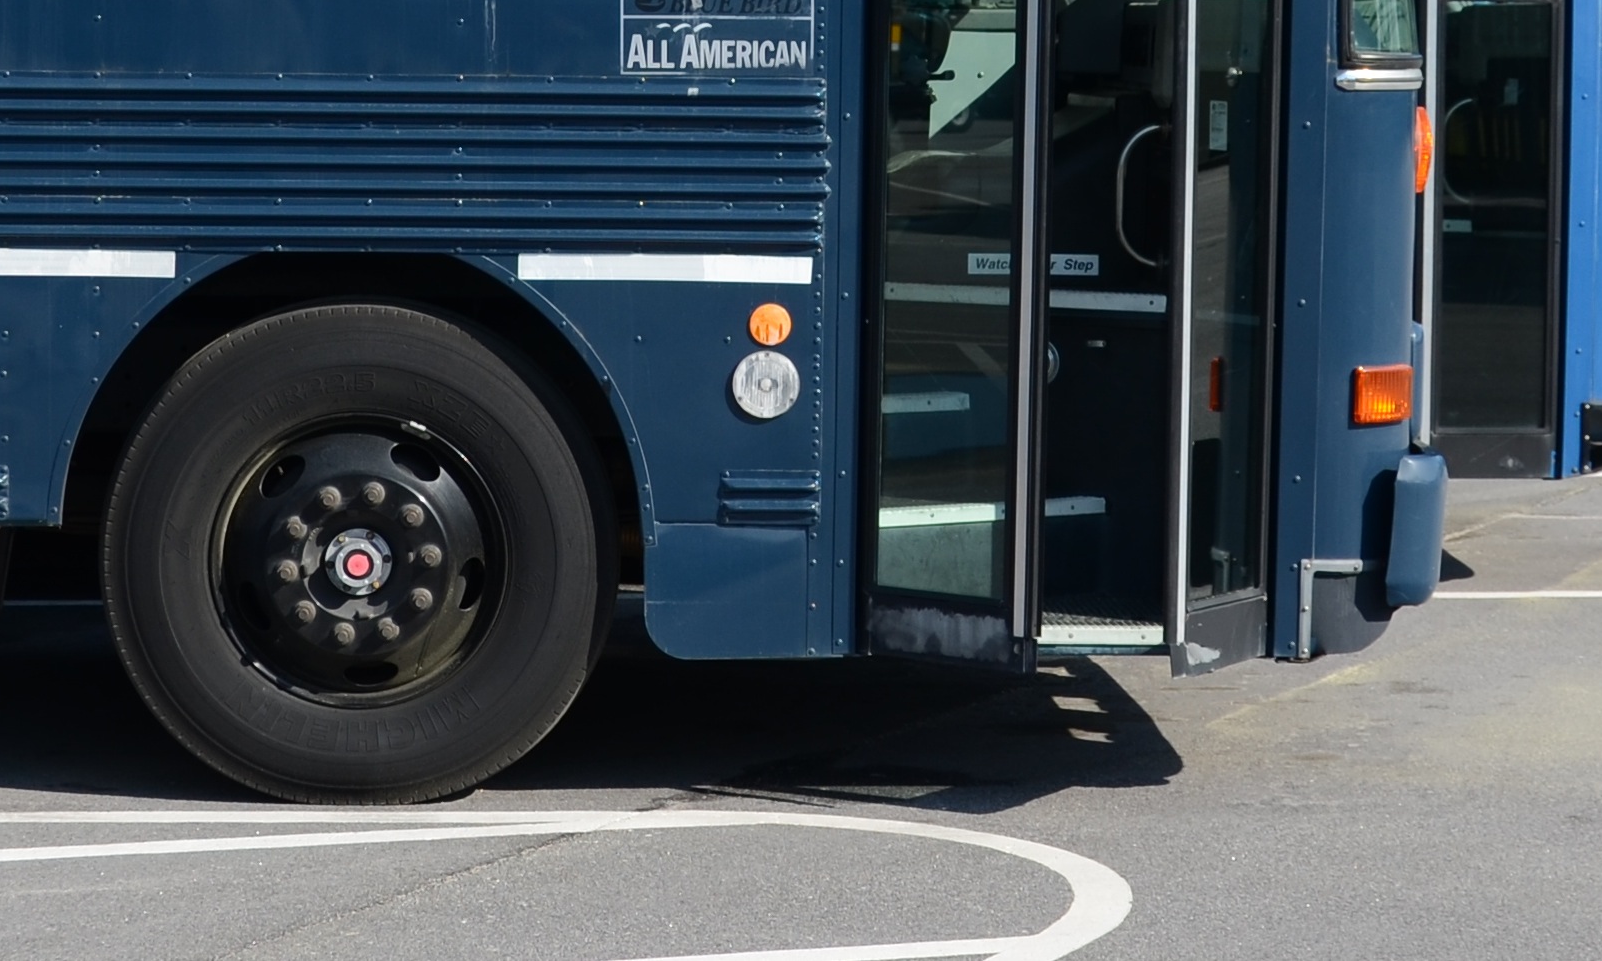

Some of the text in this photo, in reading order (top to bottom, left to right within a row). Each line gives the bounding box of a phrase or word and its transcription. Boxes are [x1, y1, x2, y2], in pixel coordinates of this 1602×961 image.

[627, 33, 807, 70] ALL AMERICAN
[976, 257, 1011, 270] Watc
[1063, 258, 1094, 273] Step
[224, 681, 481, 754] MICHELIN
